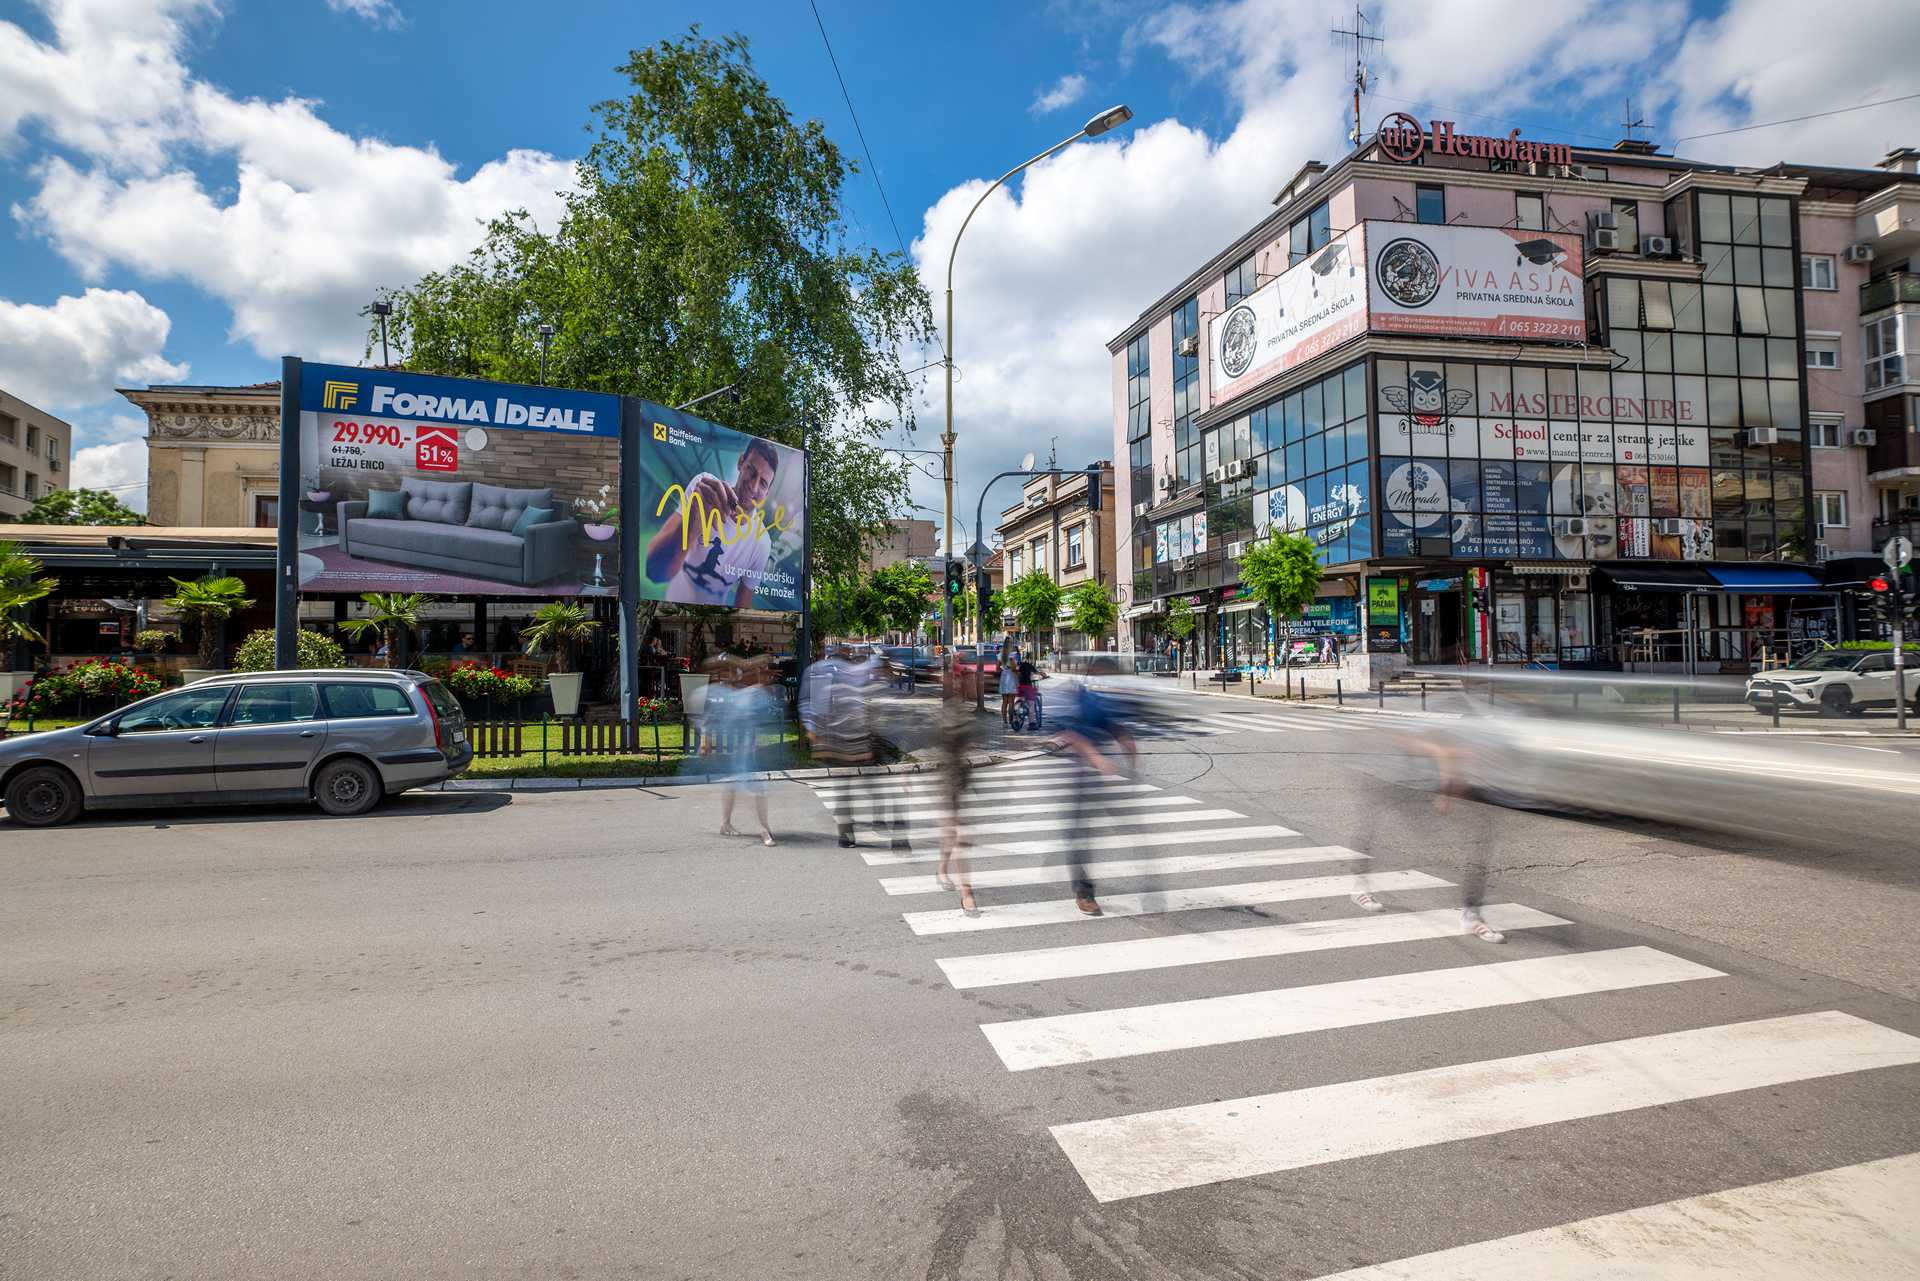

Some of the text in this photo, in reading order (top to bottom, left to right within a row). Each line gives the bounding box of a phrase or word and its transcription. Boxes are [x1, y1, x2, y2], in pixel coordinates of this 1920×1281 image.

[1430, 120, 1572, 165] Hemofarm
[1439, 264, 1573, 294] VIVA ASJA
[1456, 291, 1575, 308] PRIVATNA SREDNJA ŠKOLA
[1267, 325, 1299, 348] PRIVATNA
[1299, 307, 1330, 331] SREDNJA
[1510, 321, 1581, 336] 065 3222 210
[371, 385, 596, 433] FORMA IDEALE
[1490, 391, 1692, 421] MASTERCENTRE
[333, 421, 412, 448] 29.990,-
[668, 426, 702, 444] Raiffeisen
[669, 436, 686, 448] Bank
[1494, 423, 1695, 449] School centar za strane jezike
[331, 456, 357, 469] LEŽAJ
[420, 444, 454, 463] 51%
[1312, 506, 1344, 523] ENERGY
[724, 564, 795, 587] Uz pravu podršku
[754, 585, 796, 600] sve može!
[1312, 618, 1349, 628] TELEFONI
